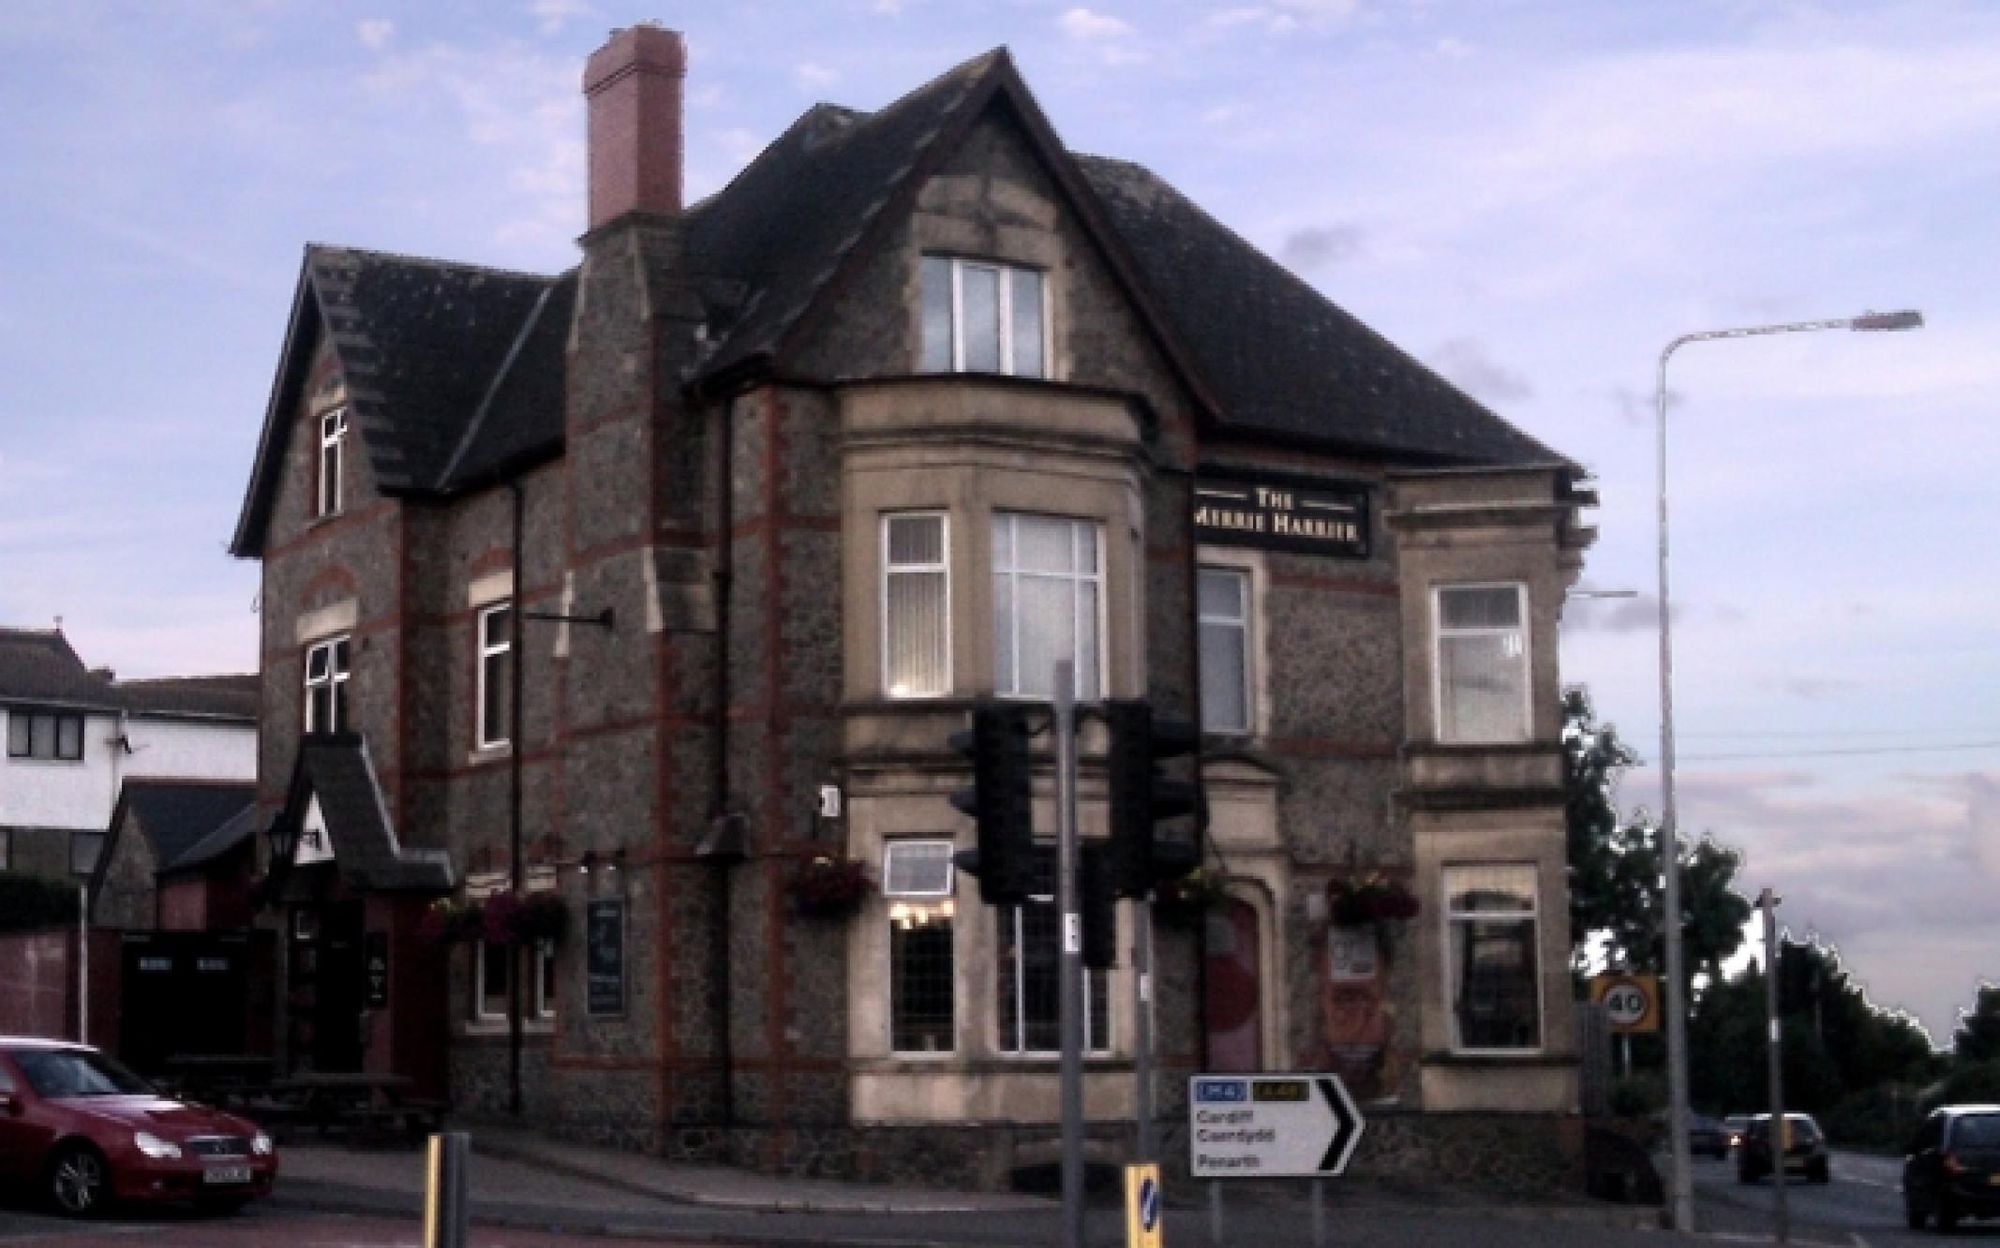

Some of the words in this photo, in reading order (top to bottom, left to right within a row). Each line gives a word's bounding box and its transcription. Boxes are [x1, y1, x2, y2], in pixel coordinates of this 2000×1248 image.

[1256, 487, 1294, 510] THE
[1608, 993, 1643, 1014] 40
[1197, 1110, 1254, 1124] Cardiff
[1197, 1128, 1276, 1145] Caerdydd
[1197, 1154, 1261, 1168] Penarth
